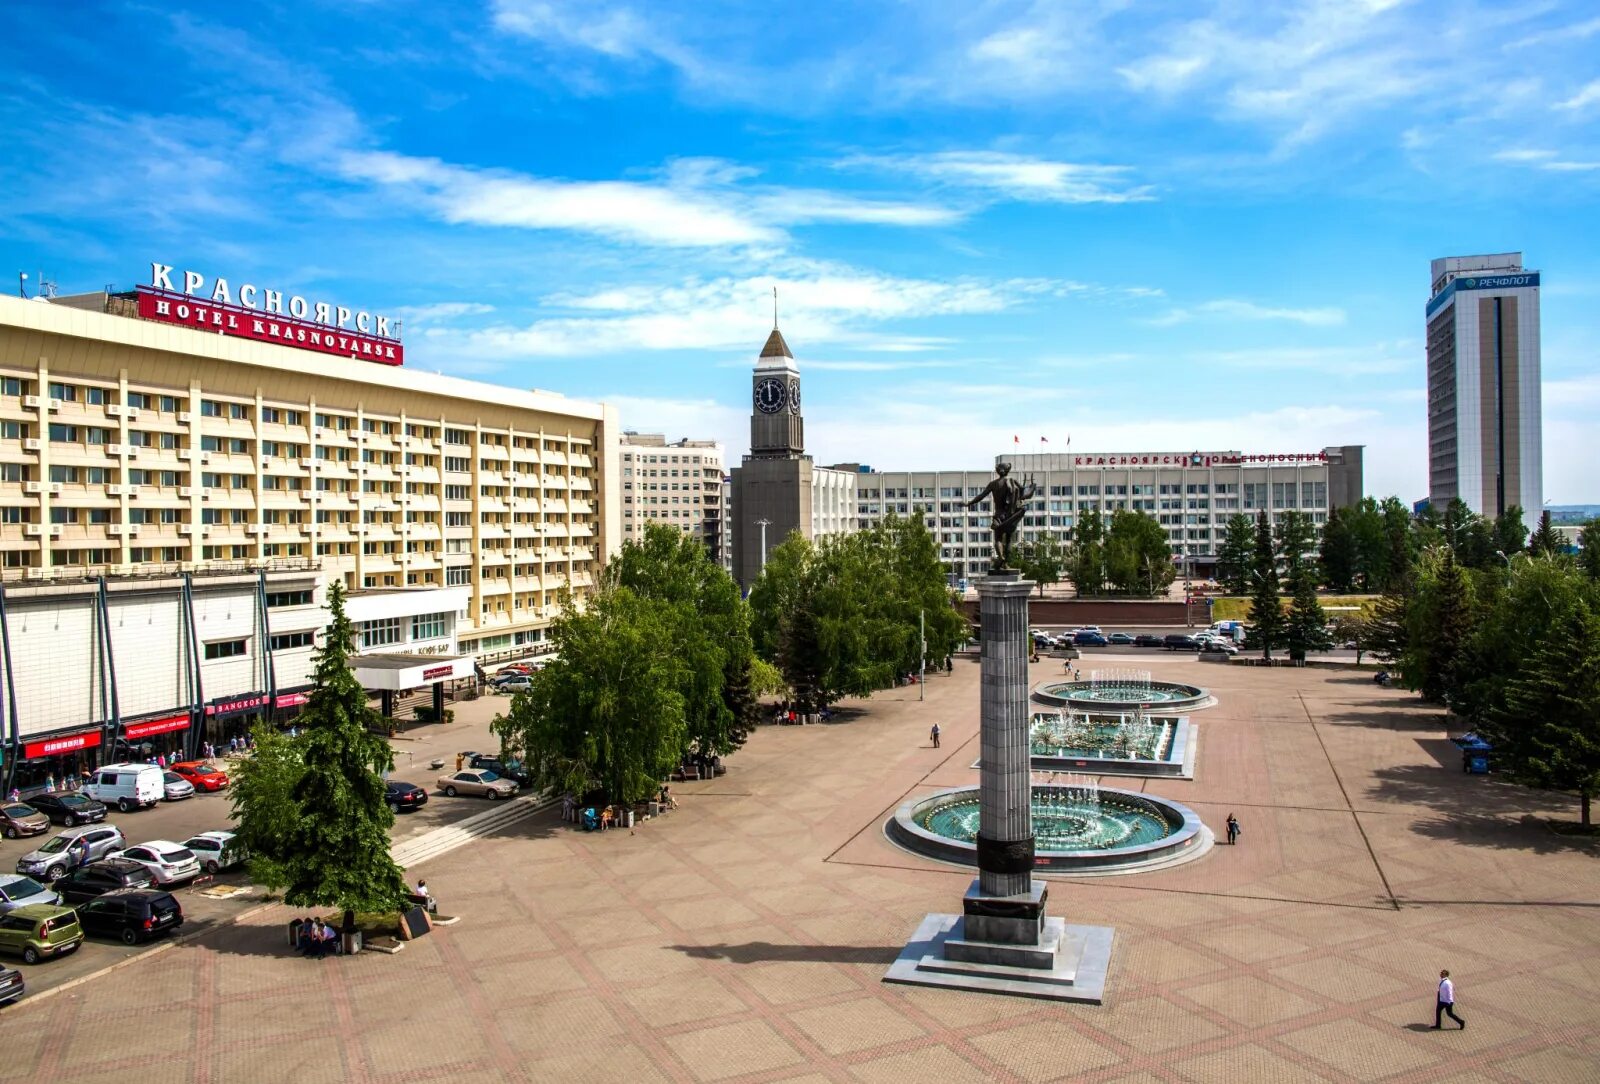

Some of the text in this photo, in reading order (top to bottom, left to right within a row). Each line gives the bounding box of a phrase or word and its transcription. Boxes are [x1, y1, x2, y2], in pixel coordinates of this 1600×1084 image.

[1479, 276, 1531, 287] РЕЧФЛОТ
[151, 262, 392, 337] КРАСНОЯРСК
[155, 300, 396, 359] HOTEL KRASNOYARSK
[1075, 451, 1327, 465] КРАСНОЯРСК ОРДЕНОНОСНЫЙ
[218, 698, 260, 712] BANGKOK
